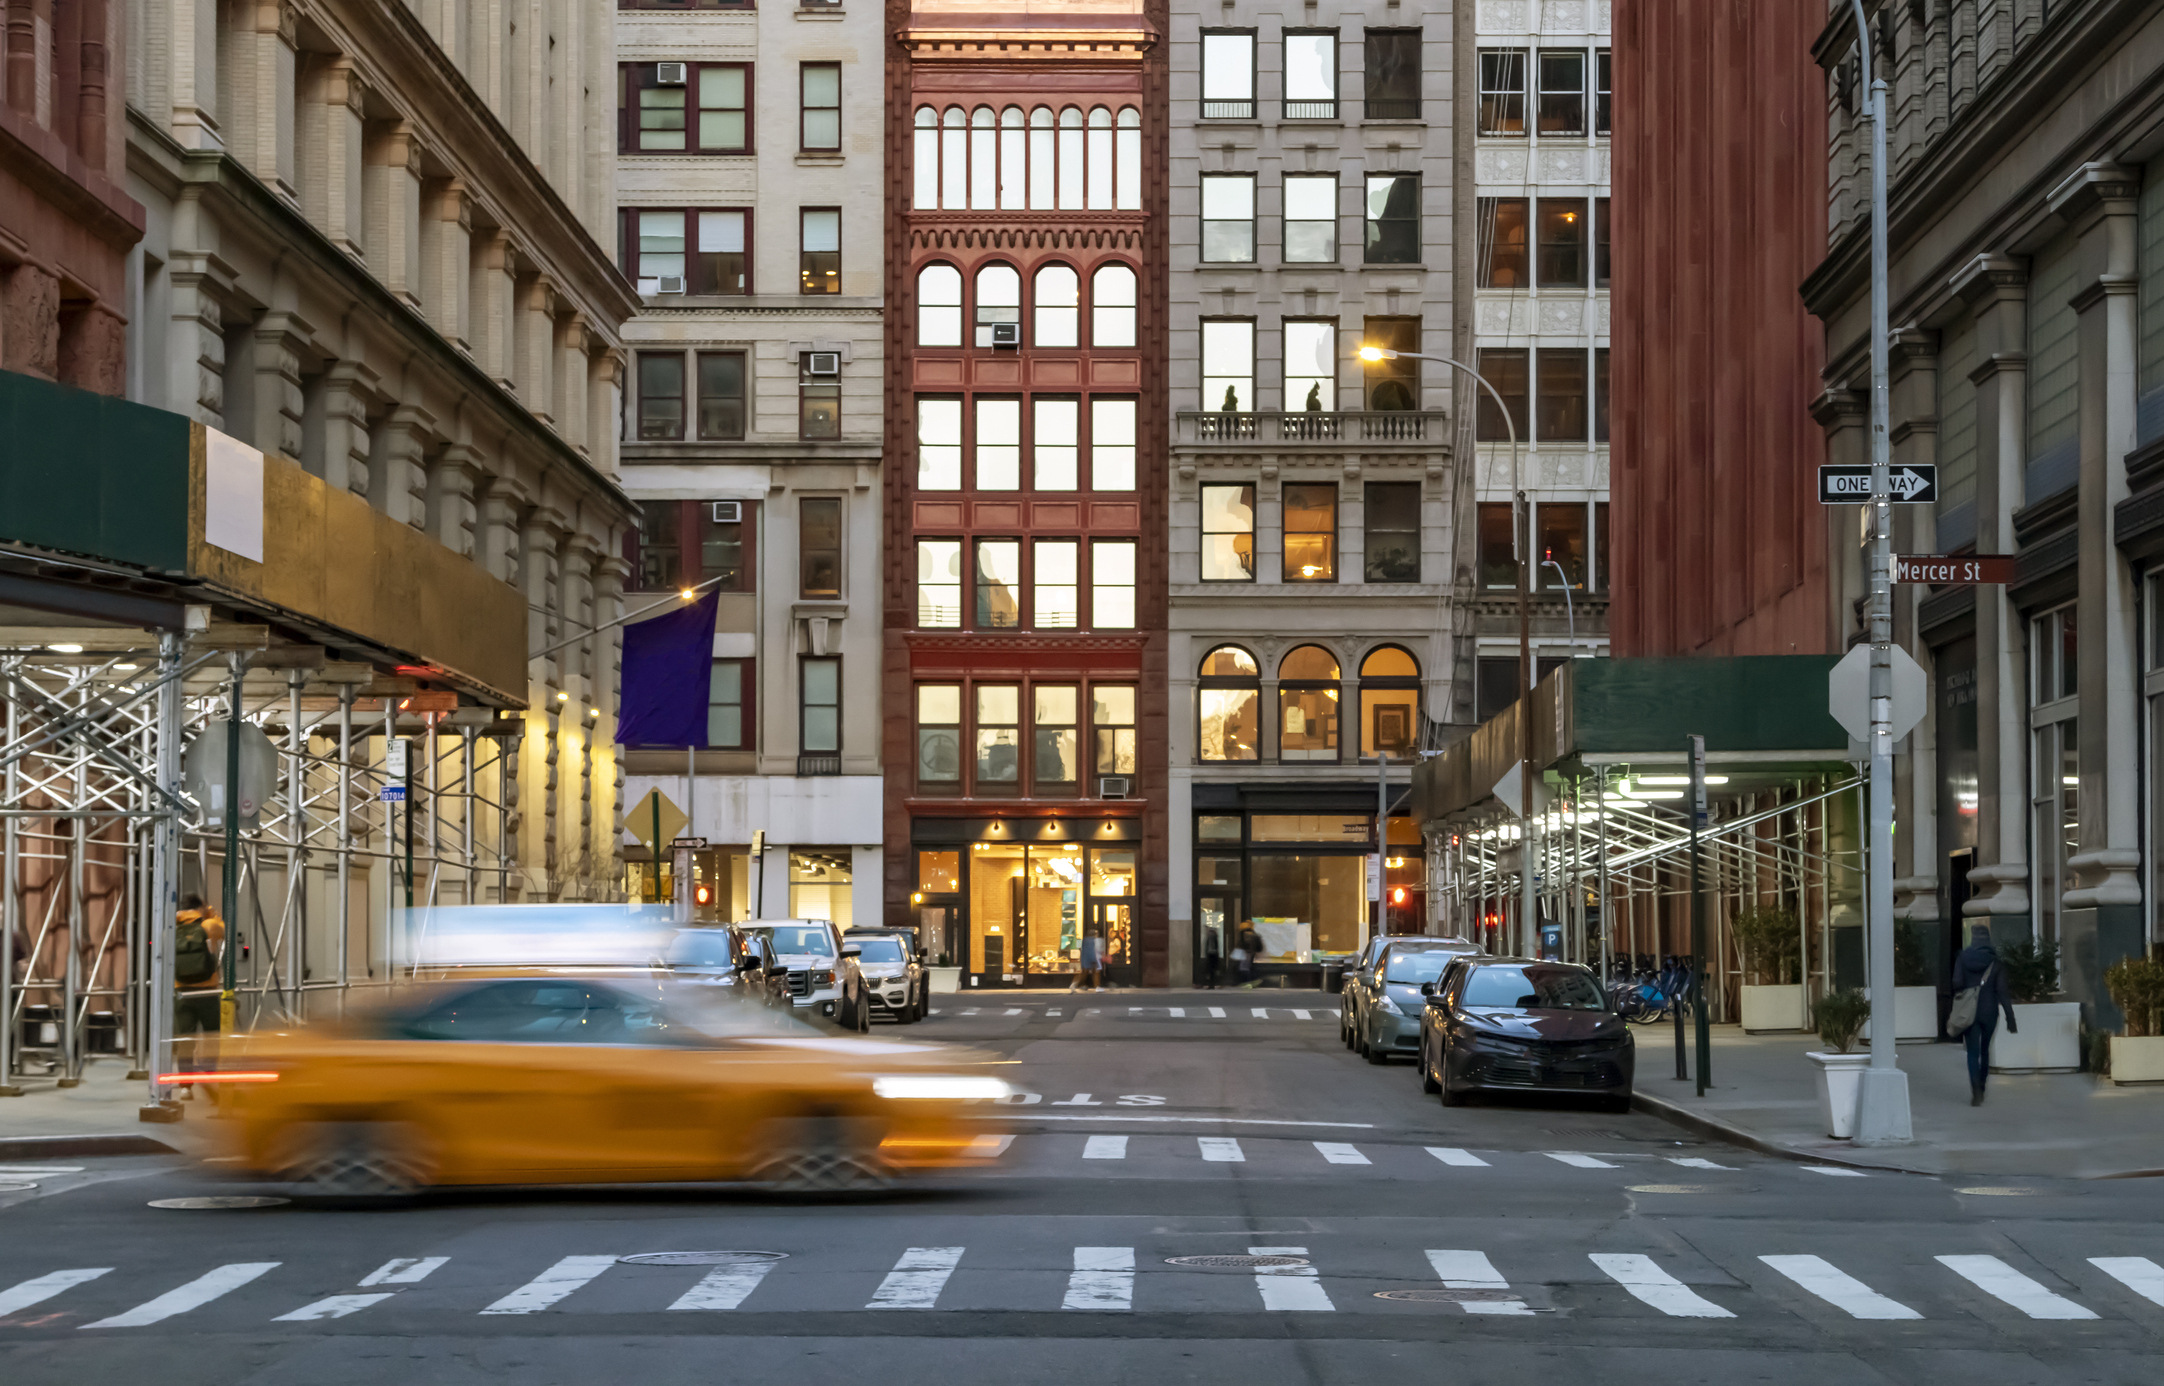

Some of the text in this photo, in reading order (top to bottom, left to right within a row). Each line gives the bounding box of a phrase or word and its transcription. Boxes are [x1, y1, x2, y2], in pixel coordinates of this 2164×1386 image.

[1836, 477, 1869, 492] ONE
[1897, 562, 1981, 580] Mercer St
[1548, 933, 1556, 945] P
[963, 1093, 1167, 1106] STO
